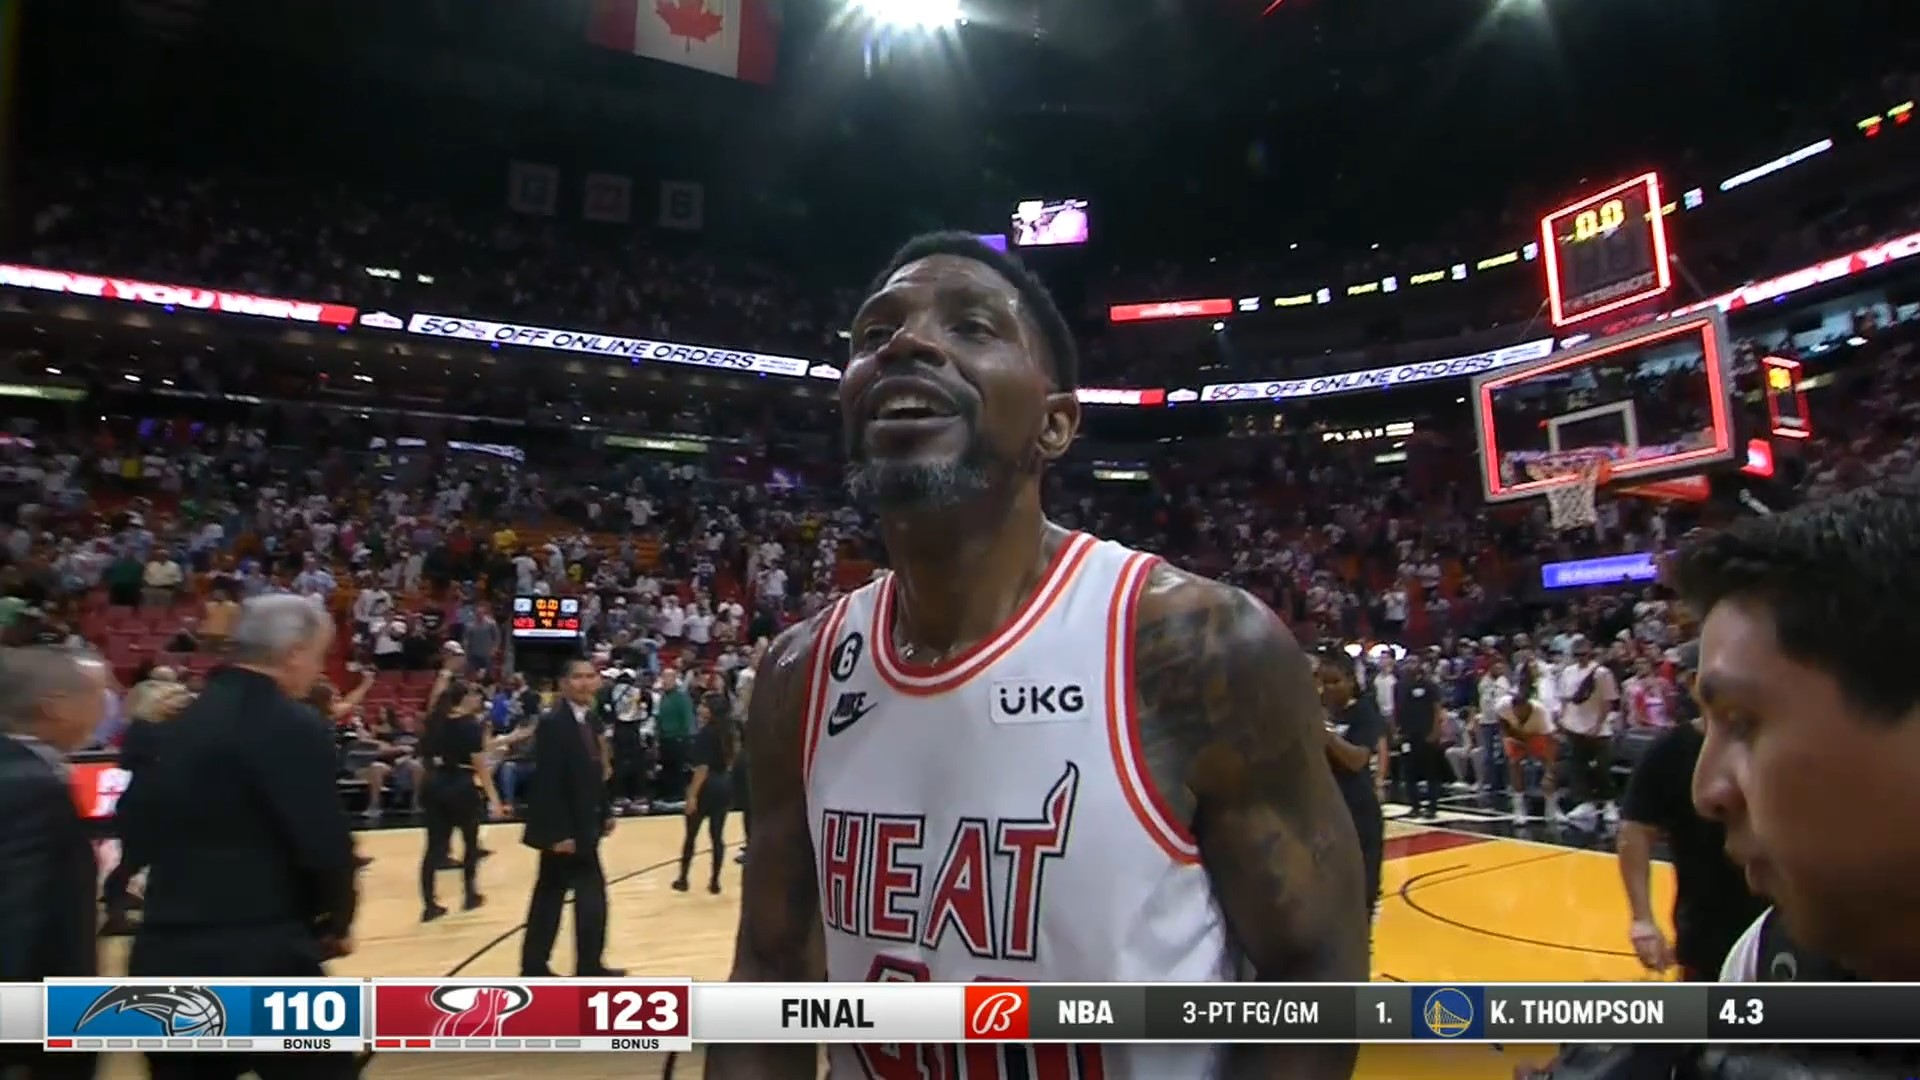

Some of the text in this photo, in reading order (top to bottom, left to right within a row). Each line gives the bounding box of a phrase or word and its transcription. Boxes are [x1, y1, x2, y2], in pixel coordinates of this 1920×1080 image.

[420, 317, 486, 337] 50%
[495, 326, 549, 343] OFF
[552, 333, 650, 356] ONLINE
[653, 344, 756, 369] ORDERS
[1265, 381, 1307, 396] OFF
[1310, 370, 1392, 393] ONLINE
[1397, 353, 1496, 381] ORDERS
[837, 639, 857, 677] 6
[822, 761, 1079, 960] HEAT
